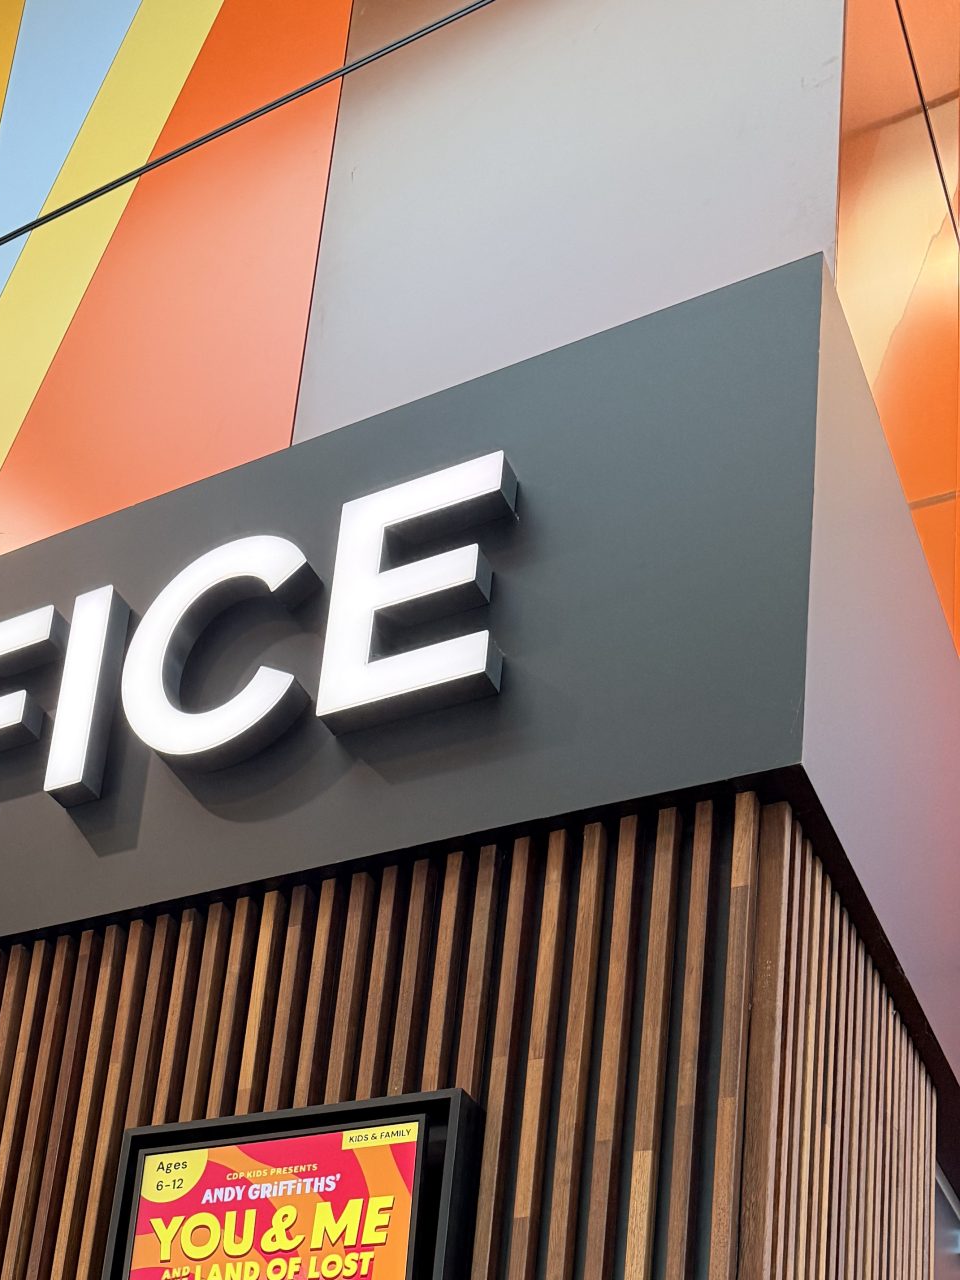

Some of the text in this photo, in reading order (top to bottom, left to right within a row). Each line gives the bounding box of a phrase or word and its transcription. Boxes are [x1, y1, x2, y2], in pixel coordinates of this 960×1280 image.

[348, 1128, 412, 1144] KIDS & FAMILY
[155, 1160, 188, 1174] Ages
[226, 1163, 318, 1181] CDP KIDS PRESENTS
[155, 1178, 185, 1191] 6-12
[201, 1184, 247, 1205] ANDY
[149, 1195, 396, 1263] YOU & ME
